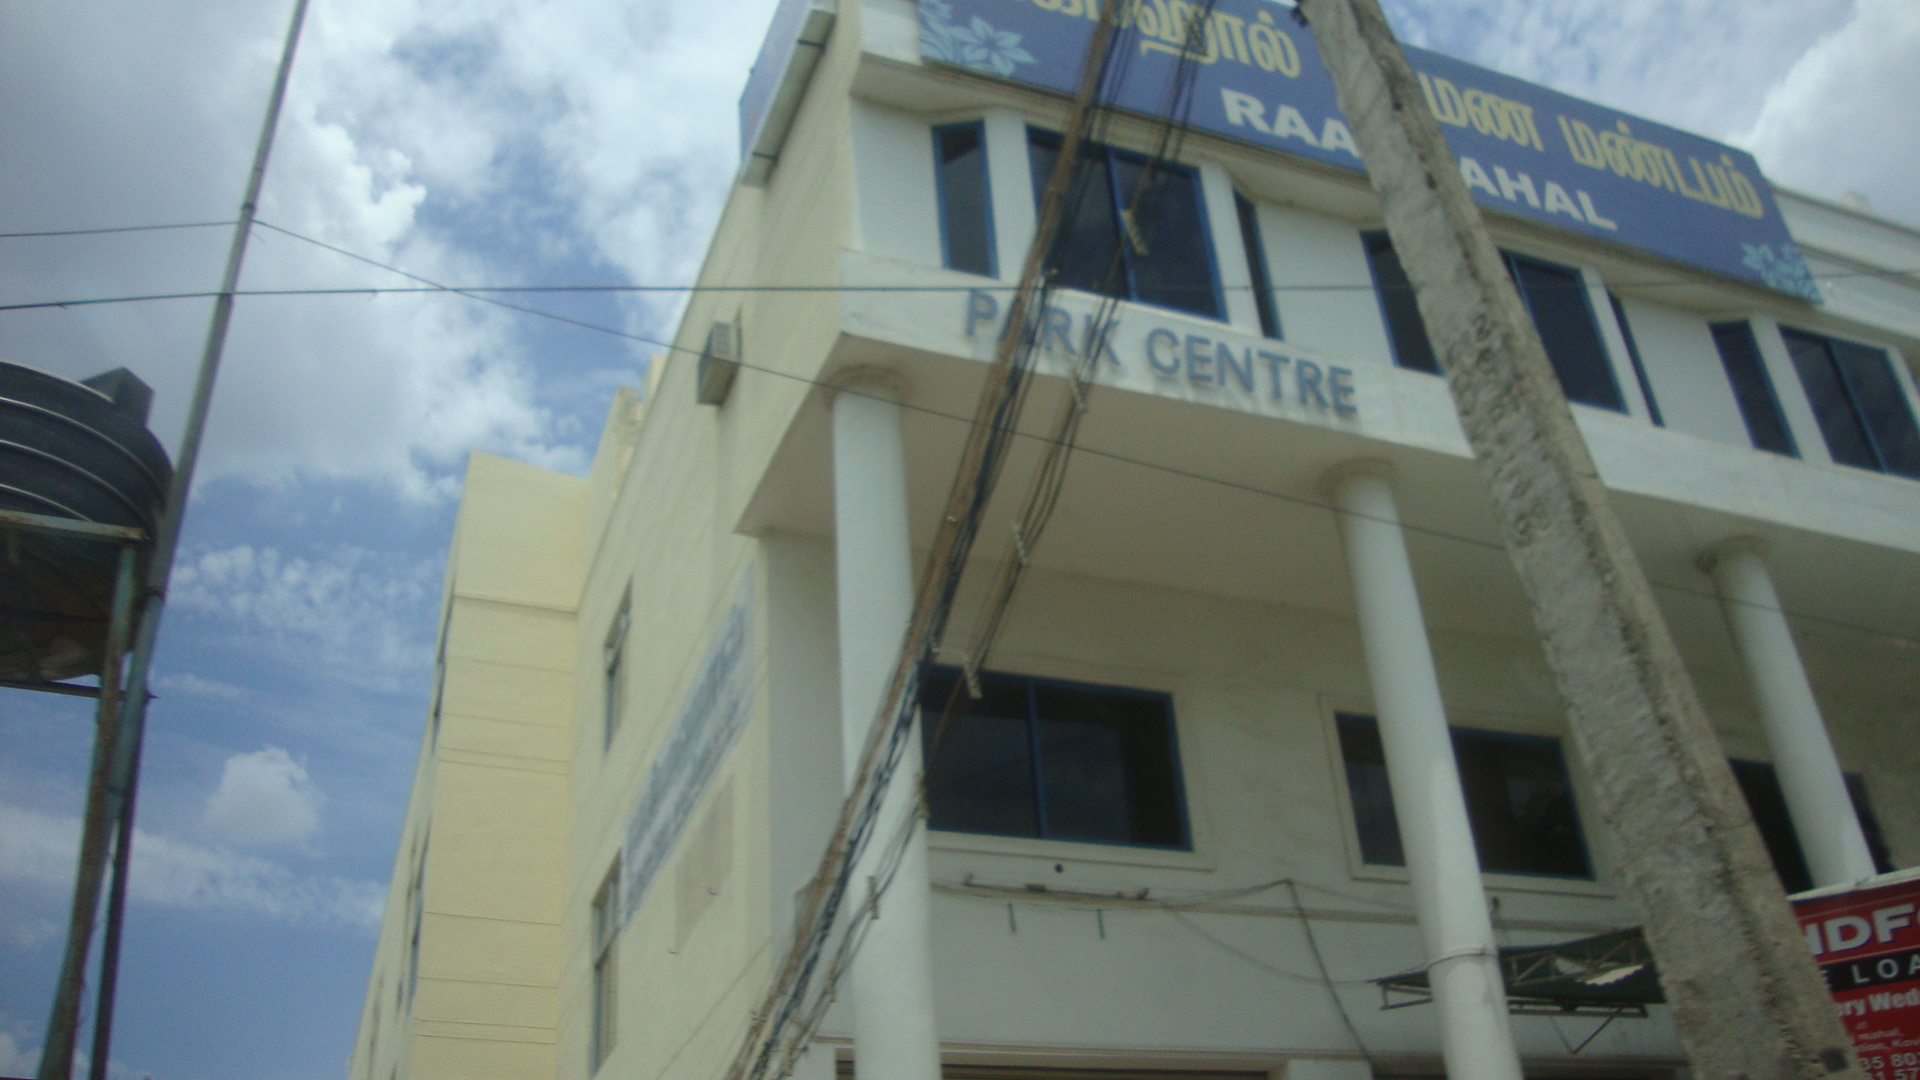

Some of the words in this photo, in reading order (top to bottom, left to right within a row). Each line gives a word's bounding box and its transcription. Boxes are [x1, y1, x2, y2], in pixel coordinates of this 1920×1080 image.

[1221, 88, 1363, 159] RAA
[1459, 156, 1619, 231] AHAL
[1417, 72, 1544, 152] மண
[1556, 118, 1765, 220] மண்டபம்
[1145, 327, 1358, 415] CENTRE
[1804, 901, 1920, 956] DF
[1850, 953, 1920, 984] LOA
[1867, 987, 1920, 1012] Wed
